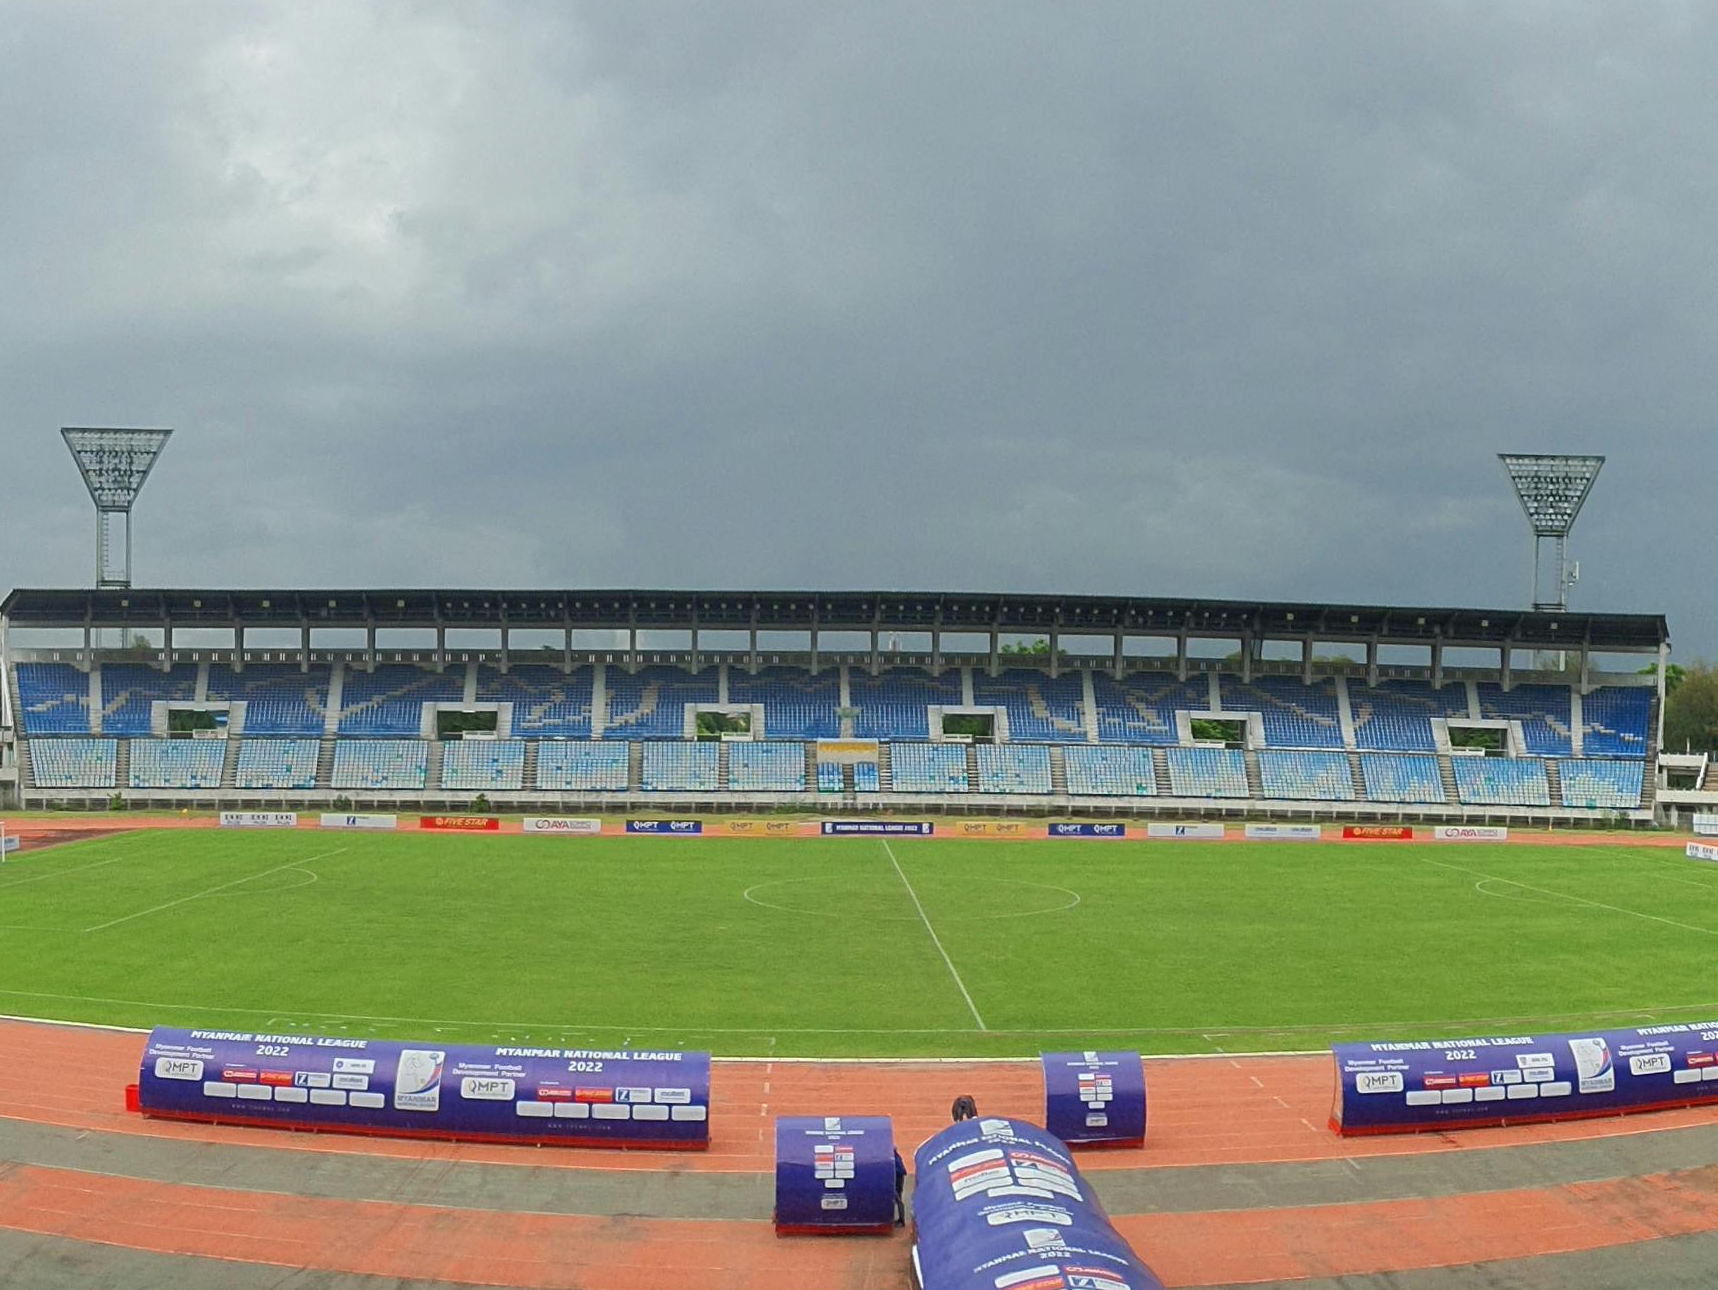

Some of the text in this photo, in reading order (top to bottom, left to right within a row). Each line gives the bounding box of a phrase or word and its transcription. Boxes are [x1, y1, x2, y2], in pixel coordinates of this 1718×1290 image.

[443, 817, 488, 827] FIVE STAR
[551, 821, 570, 829] AYA
[639, 821, 695, 829] MPT MPT
[1382, 827, 1403, 835] STAR
[255, 1034, 314, 1046] NATIONAL
[317, 1037, 368, 1049] LEAGUE
[1371, 1036, 1534, 1052] MYANMAR NATIONAL LEAGUE
[256, 1045, 289, 1057] 2022
[496, 1047, 682, 1062] MYANMAR NATIONAL LEAGUE
[1445, 1049, 1477, 1061] 2022
[173, 1061, 198, 1074] MPT
[568, 1061, 603, 1073] 2022
[1643, 1056, 1665, 1068] MPT
[477, 1081, 509, 1093] MPT
[1371, 1075, 1397, 1087] MPT
[1027, 1245, 1087, 1255] NATIONAL
[1039, 1251, 1072, 1259] 2022
